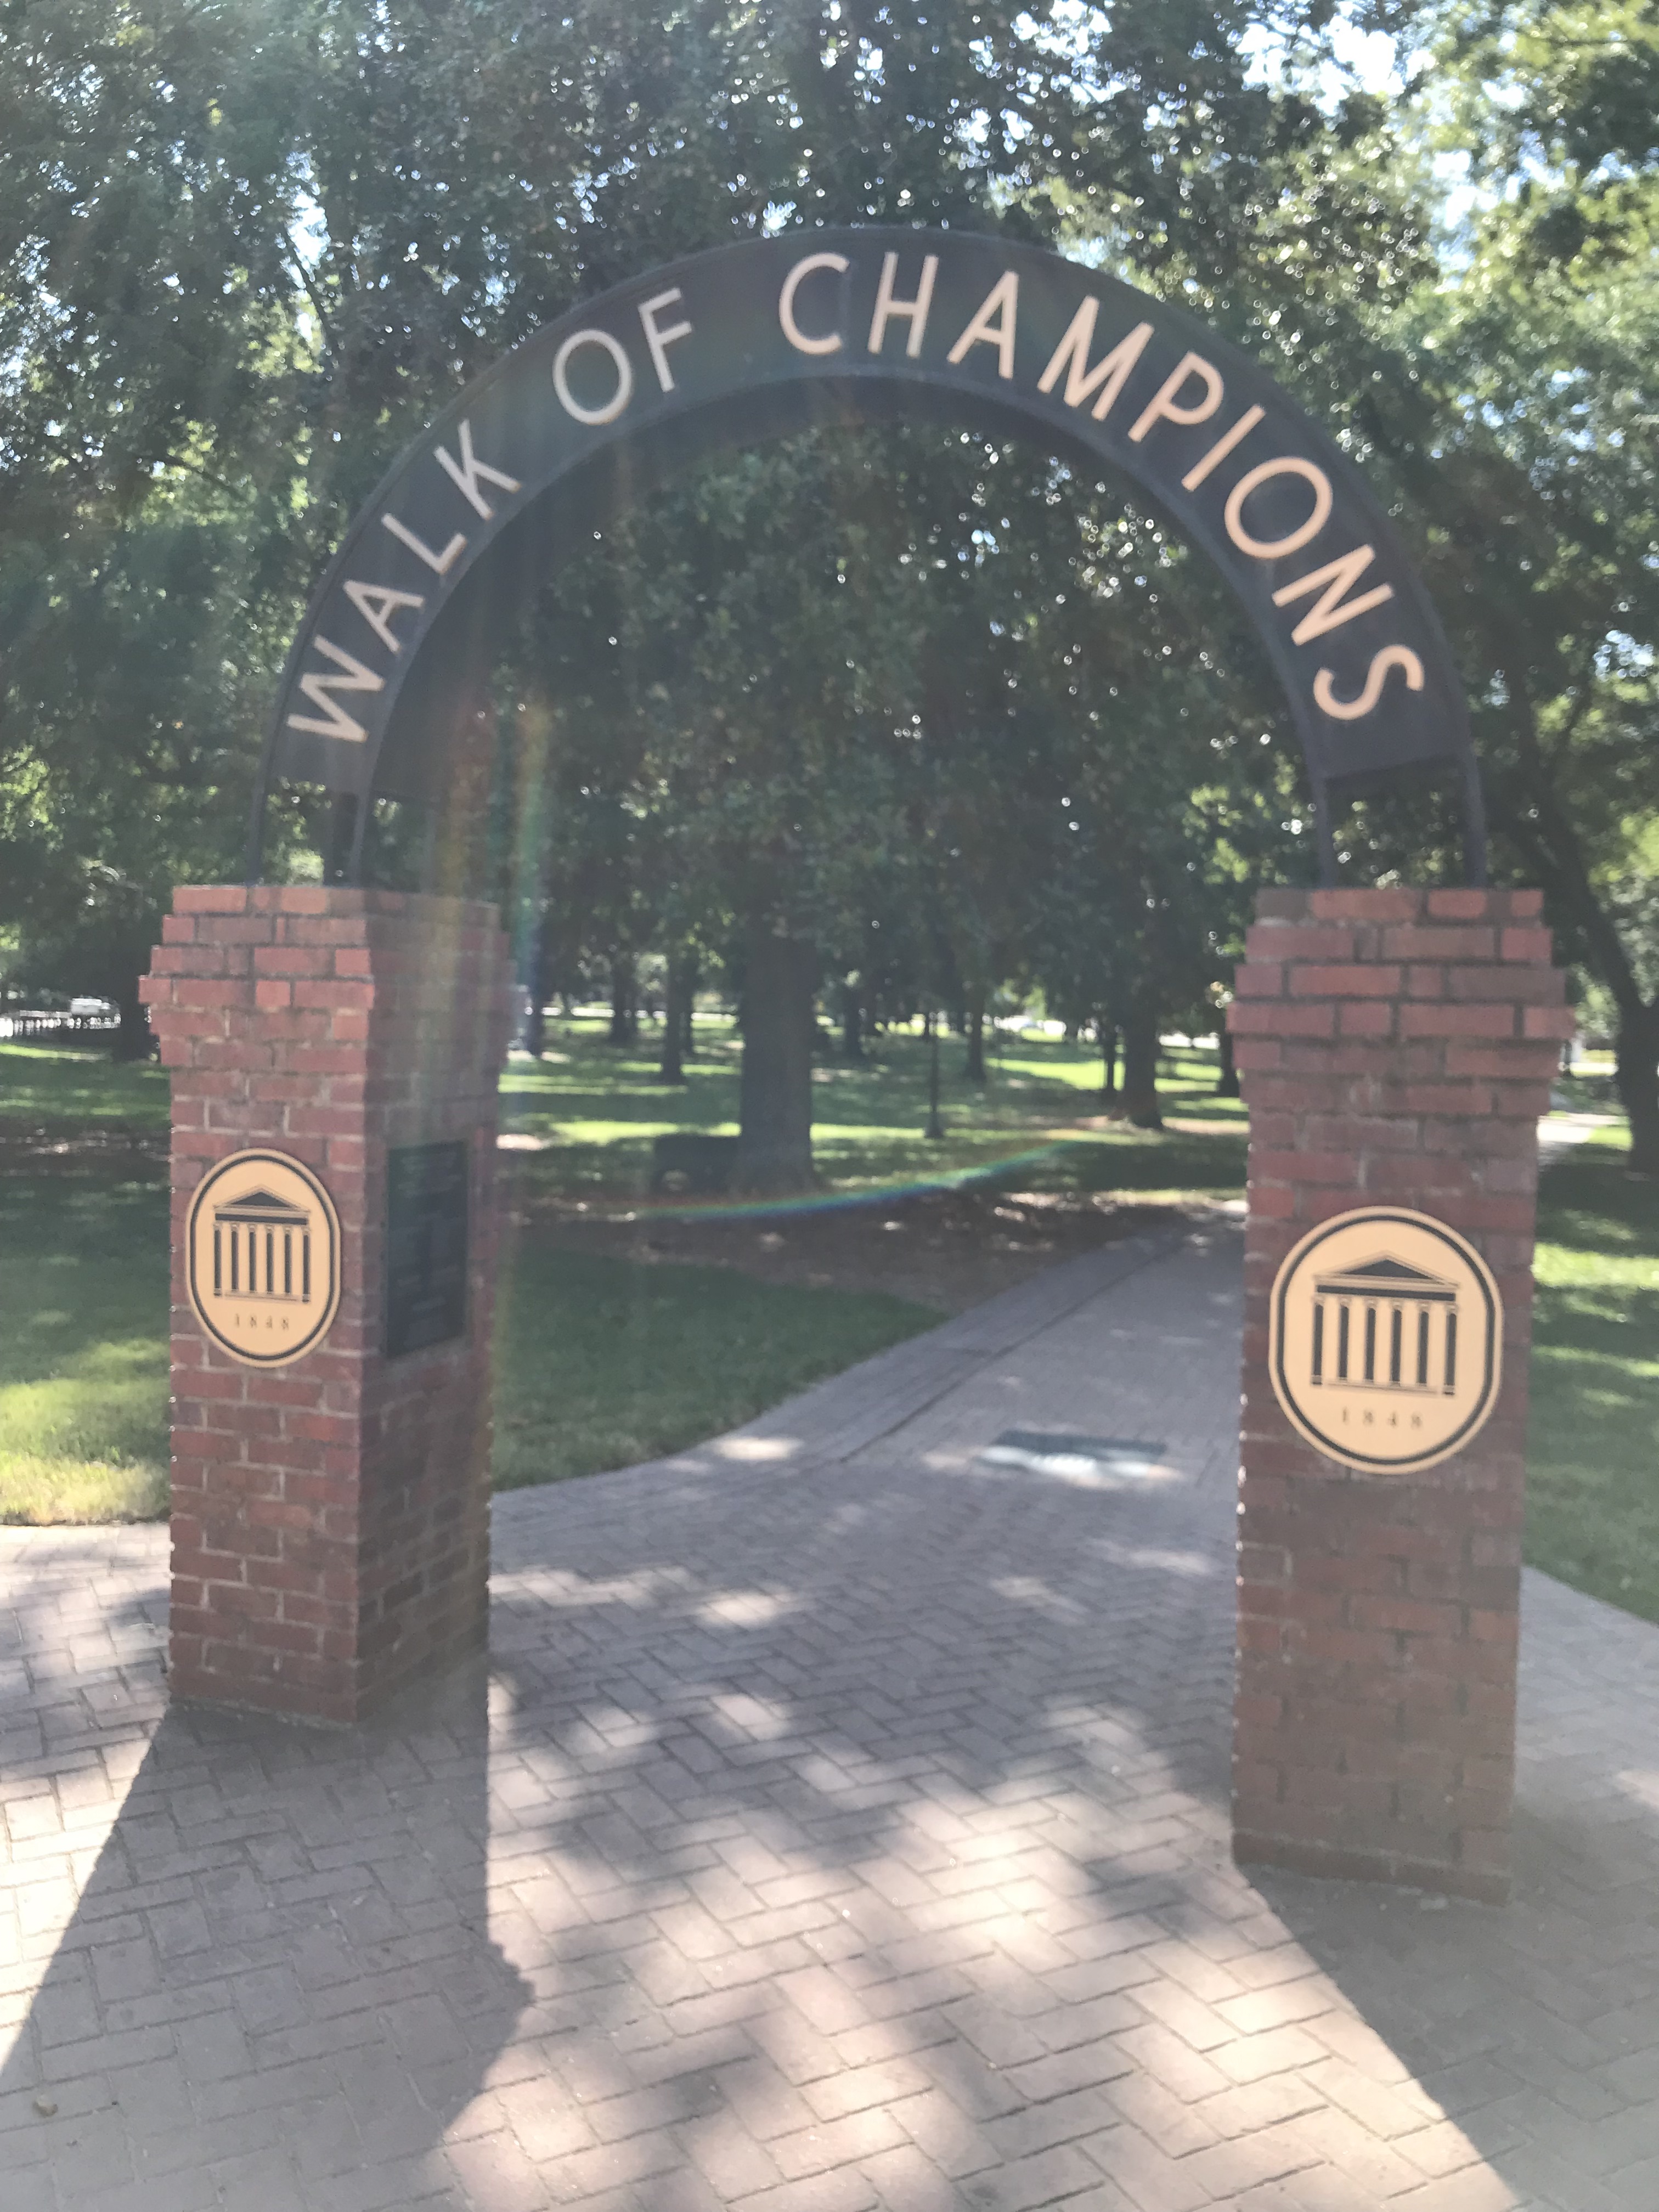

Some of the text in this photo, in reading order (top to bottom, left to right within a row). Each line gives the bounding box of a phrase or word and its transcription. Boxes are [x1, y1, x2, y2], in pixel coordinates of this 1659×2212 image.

[286, 251, 1424, 743] WALK OF CHAMPIONS
